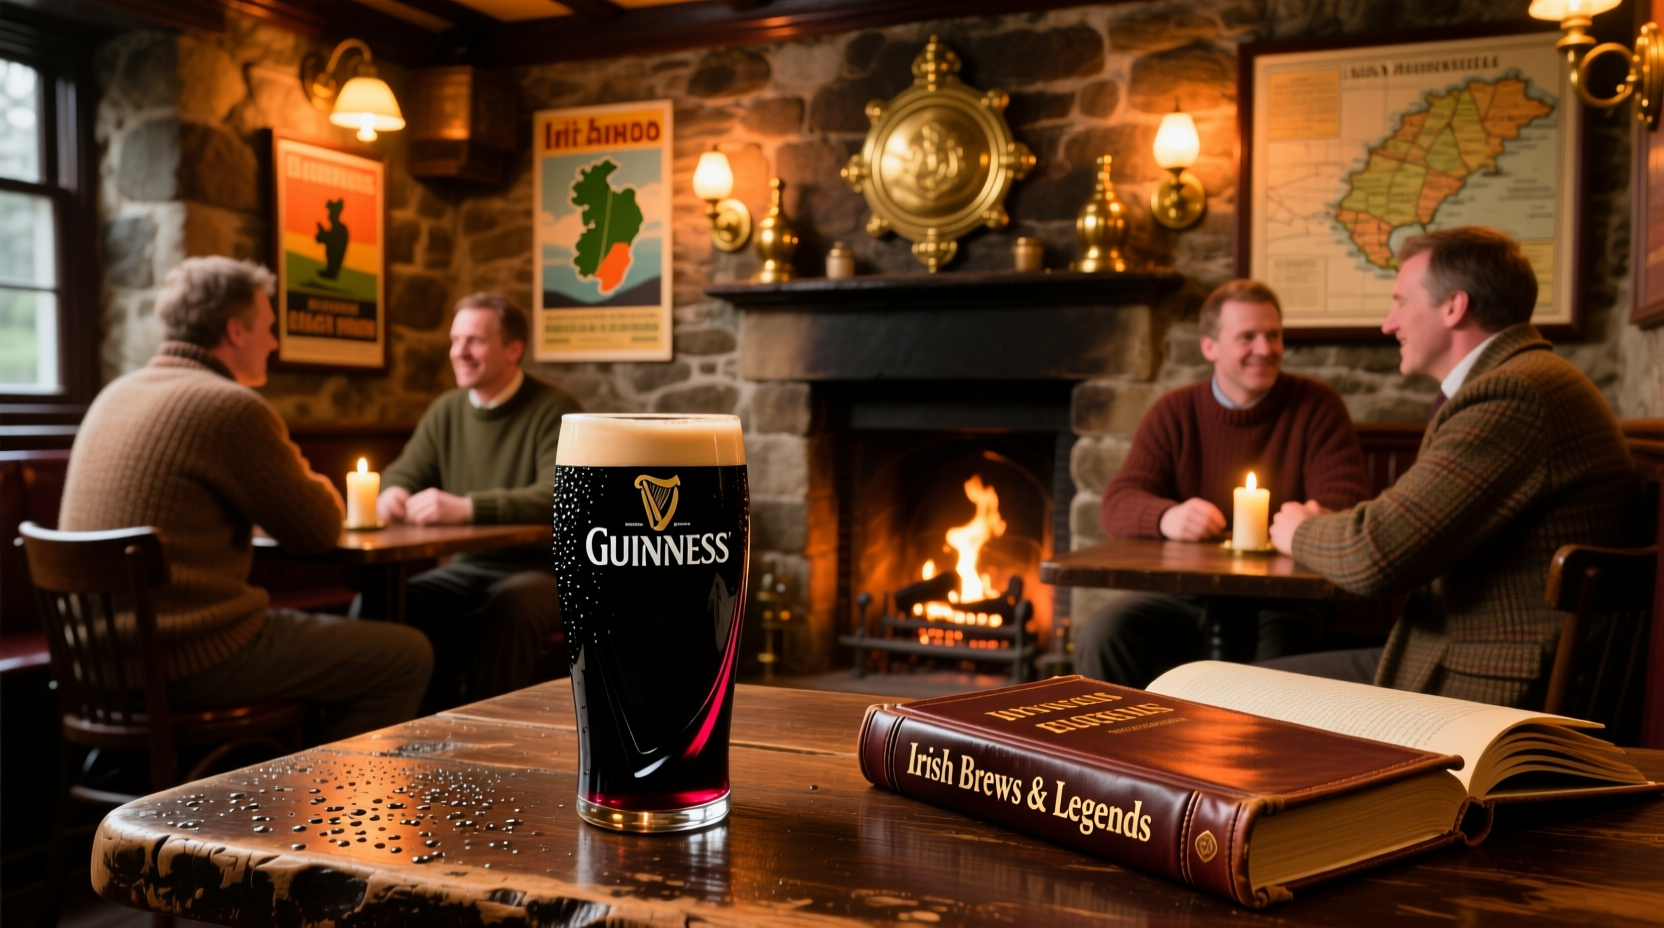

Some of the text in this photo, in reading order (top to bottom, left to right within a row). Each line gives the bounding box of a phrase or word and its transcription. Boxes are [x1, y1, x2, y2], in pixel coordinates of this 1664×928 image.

[907, 742, 1152, 842] Irish Brews & Legends
